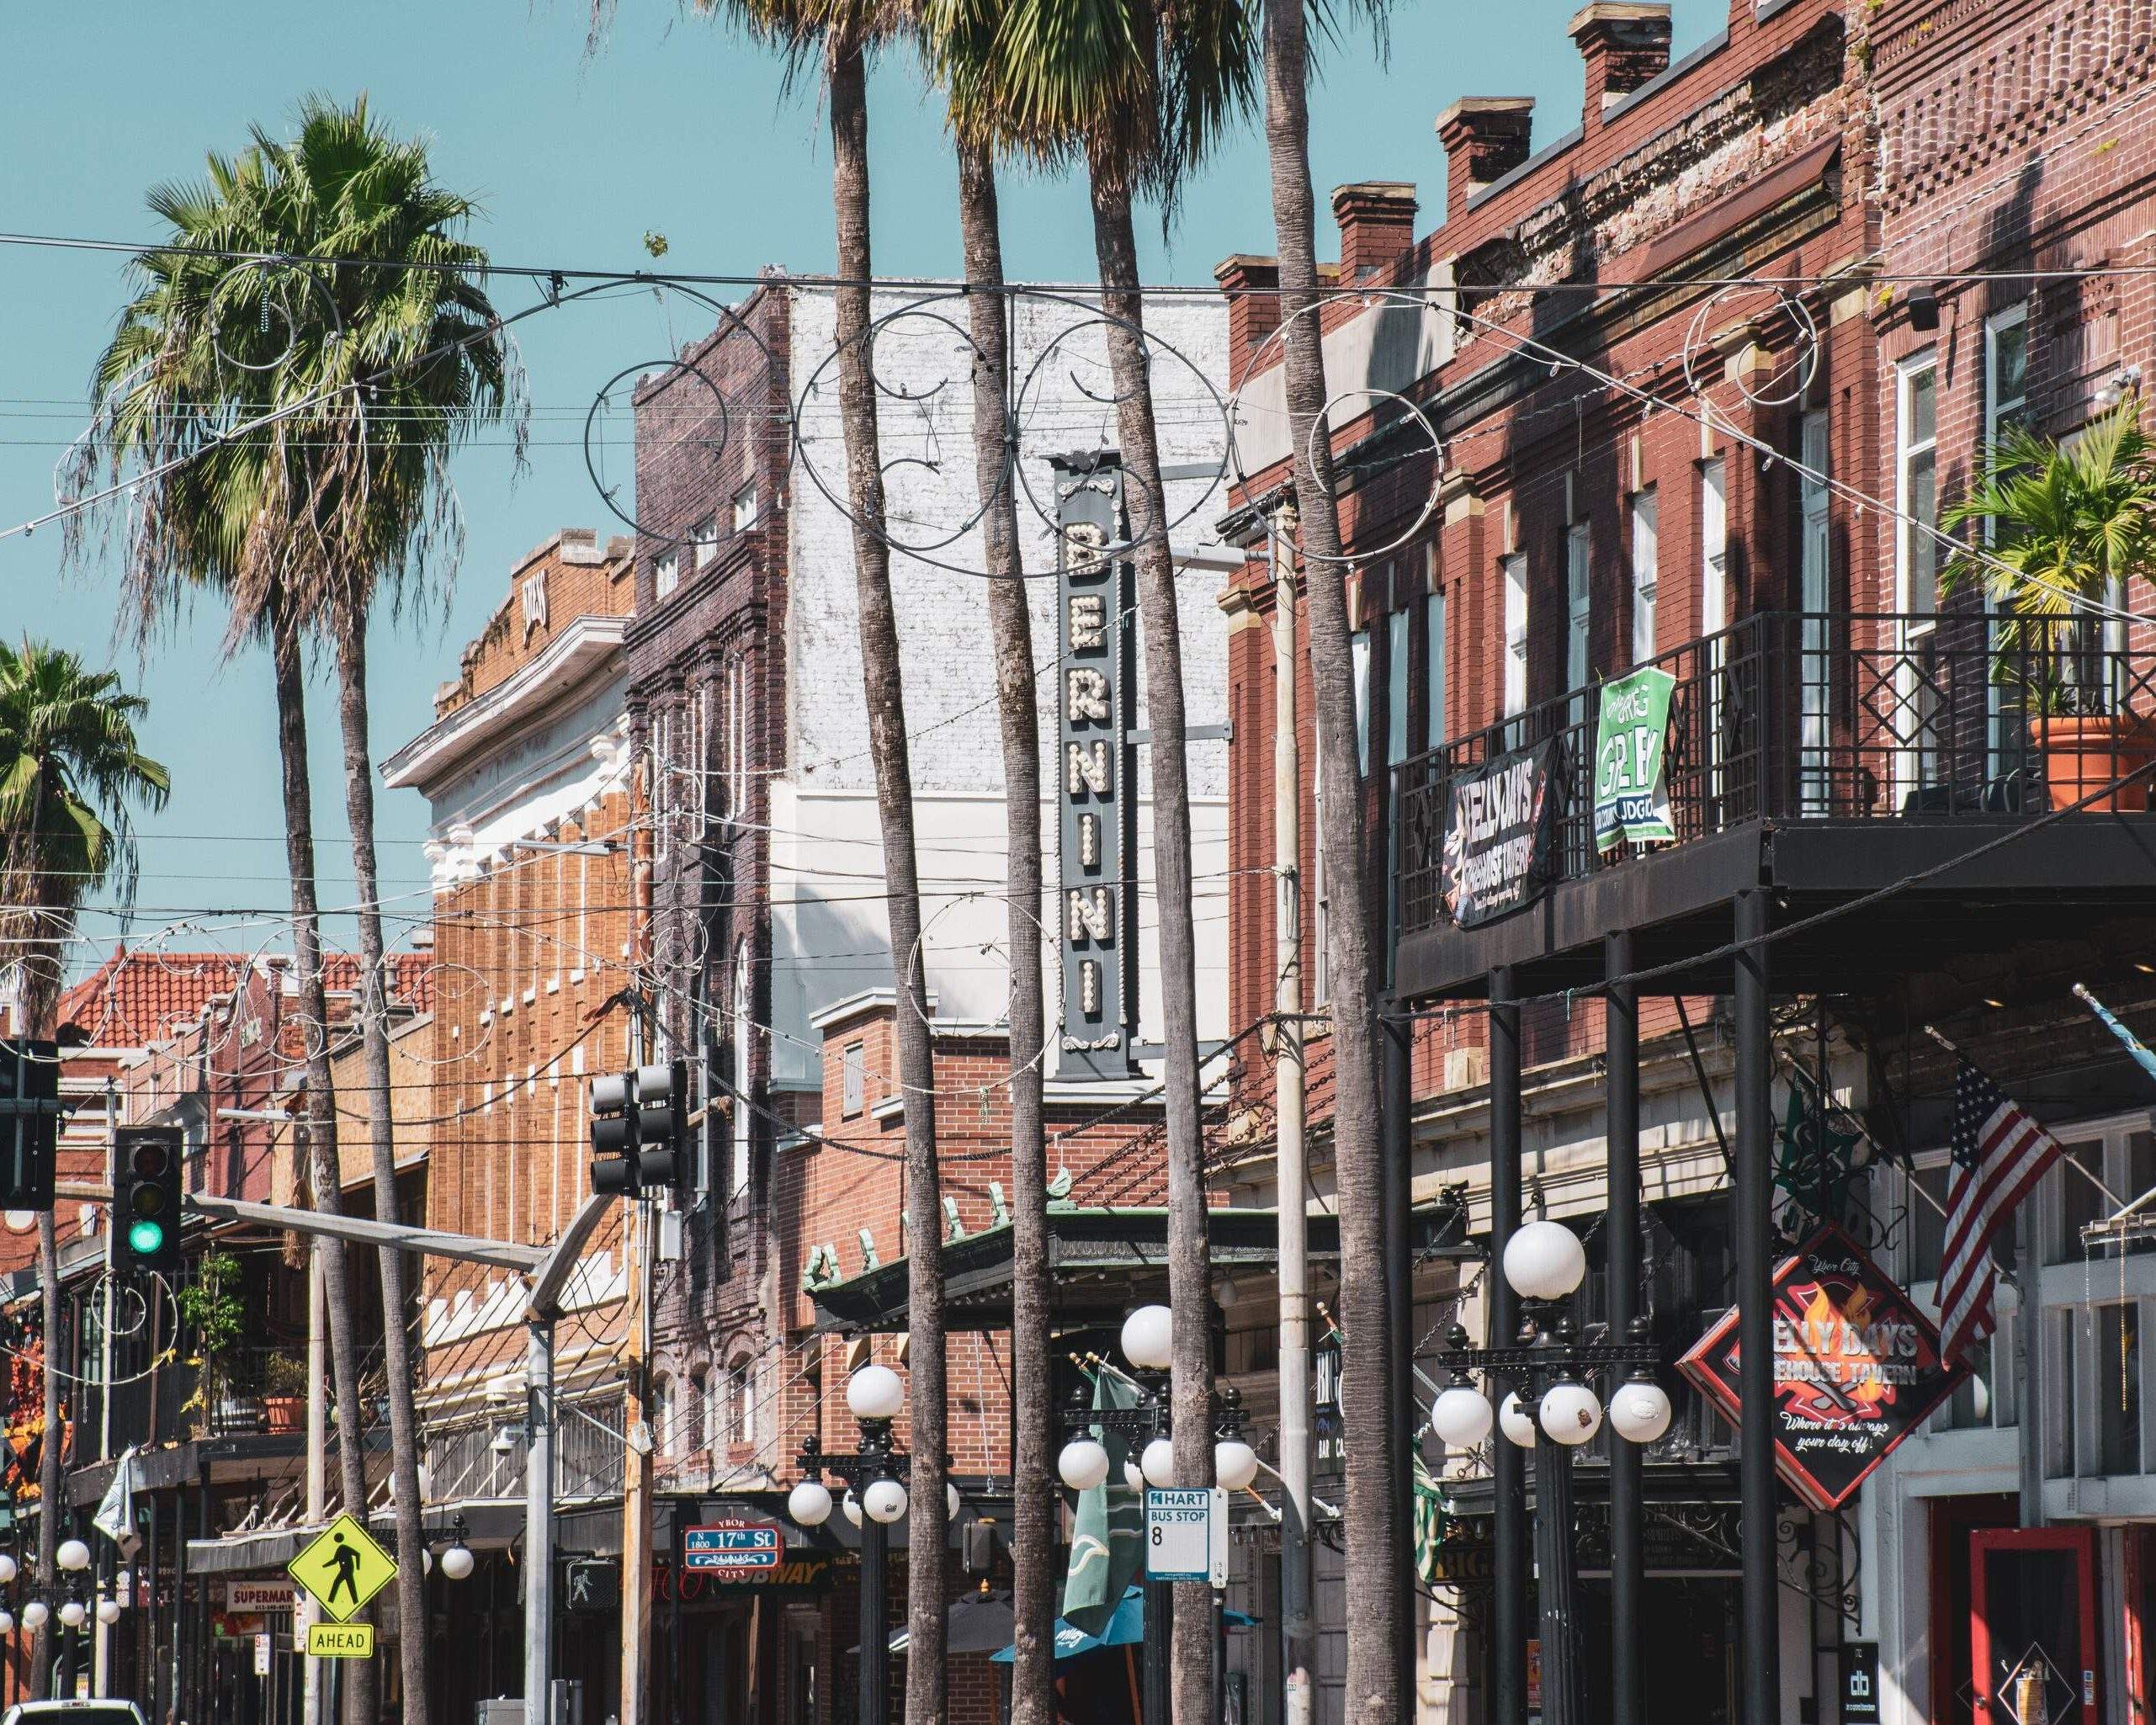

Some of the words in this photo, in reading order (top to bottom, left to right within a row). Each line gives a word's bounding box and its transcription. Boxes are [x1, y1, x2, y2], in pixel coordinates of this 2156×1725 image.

[1064, 521, 1115, 1015] BERNINI
[1773, 1319, 1835, 1356] ELLY
[1841, 1322, 1918, 1357] DAYS
[1773, 1360, 1842, 1383] EHOUSE
[1850, 1362, 1917, 1386] TAVERN
[1780, 1412, 1822, 1430] Where
[1795, 1437, 1825, 1452] your
[1828, 1435, 1851, 1453] day
[1165, 1493, 1205, 1505] HART
[719, 1519, 746, 1528] YBOR
[1151, 1511, 1172, 1522] BUS
[1176, 1511, 1205, 1522] STOP
[717, 1531, 746, 1548] 17th
[754, 1531, 771, 1547] St
[1152, 1526, 1162, 1546] 8
[691, 1541, 710, 1549] 1800
[718, 1569, 745, 1579] CITY
[234, 1590, 294, 1605] SUPERMAR
[316, 1633, 364, 1648] AHEAD
